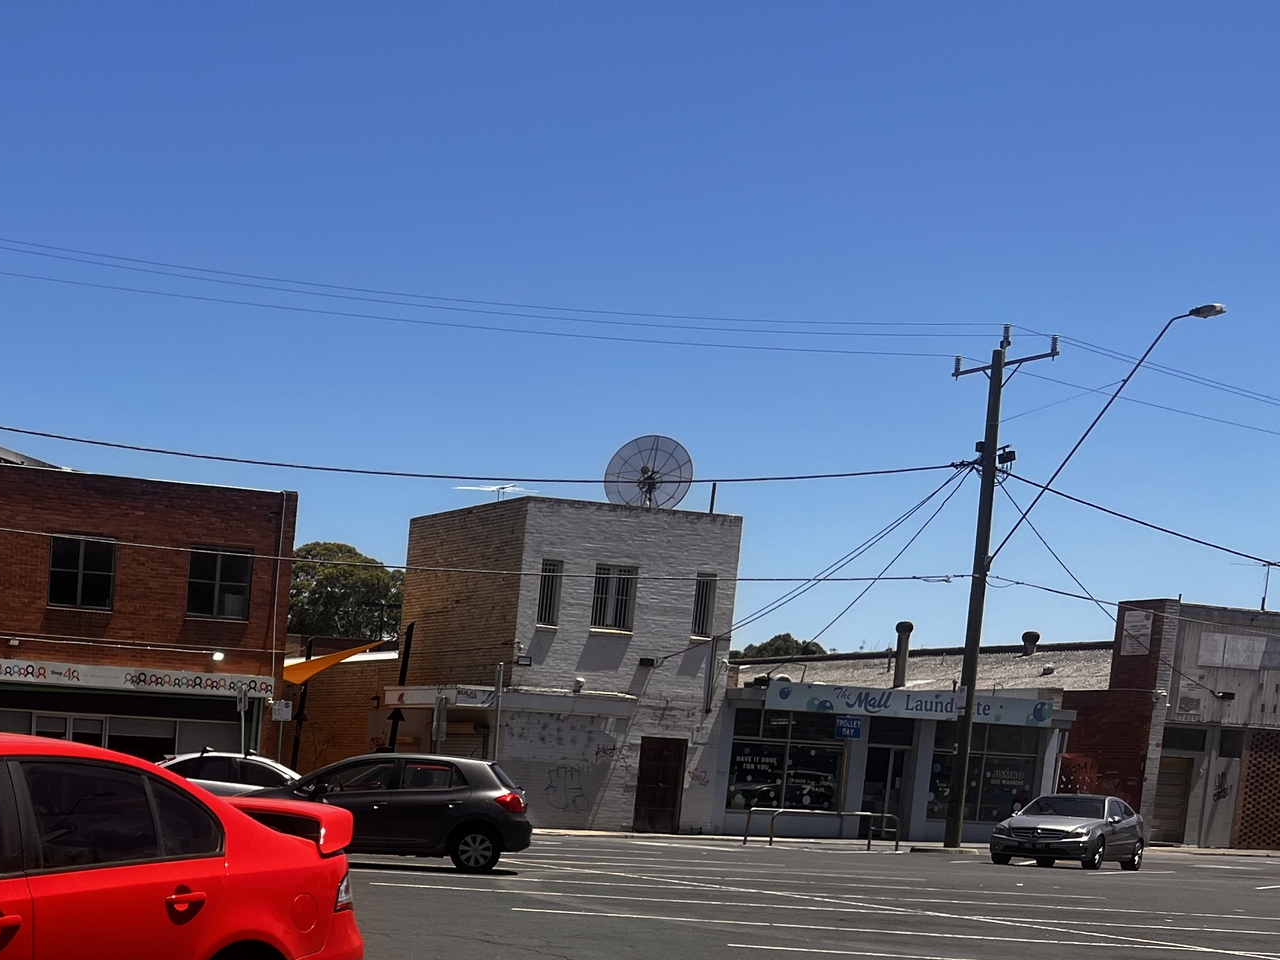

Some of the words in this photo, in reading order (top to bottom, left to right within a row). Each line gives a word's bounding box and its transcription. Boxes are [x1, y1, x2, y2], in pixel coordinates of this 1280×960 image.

[833, 687, 853, 700] The
[845, 691, 892, 715] Mall
[905, 694, 991, 716] Laundte
[836, 719, 861, 728] TROLLEY
[842, 727, 854, 736] BAY
[761, 756, 778, 764] DONE
[992, 770, 1025, 779] JUMBO
[802, 785, 812, 794] 7
